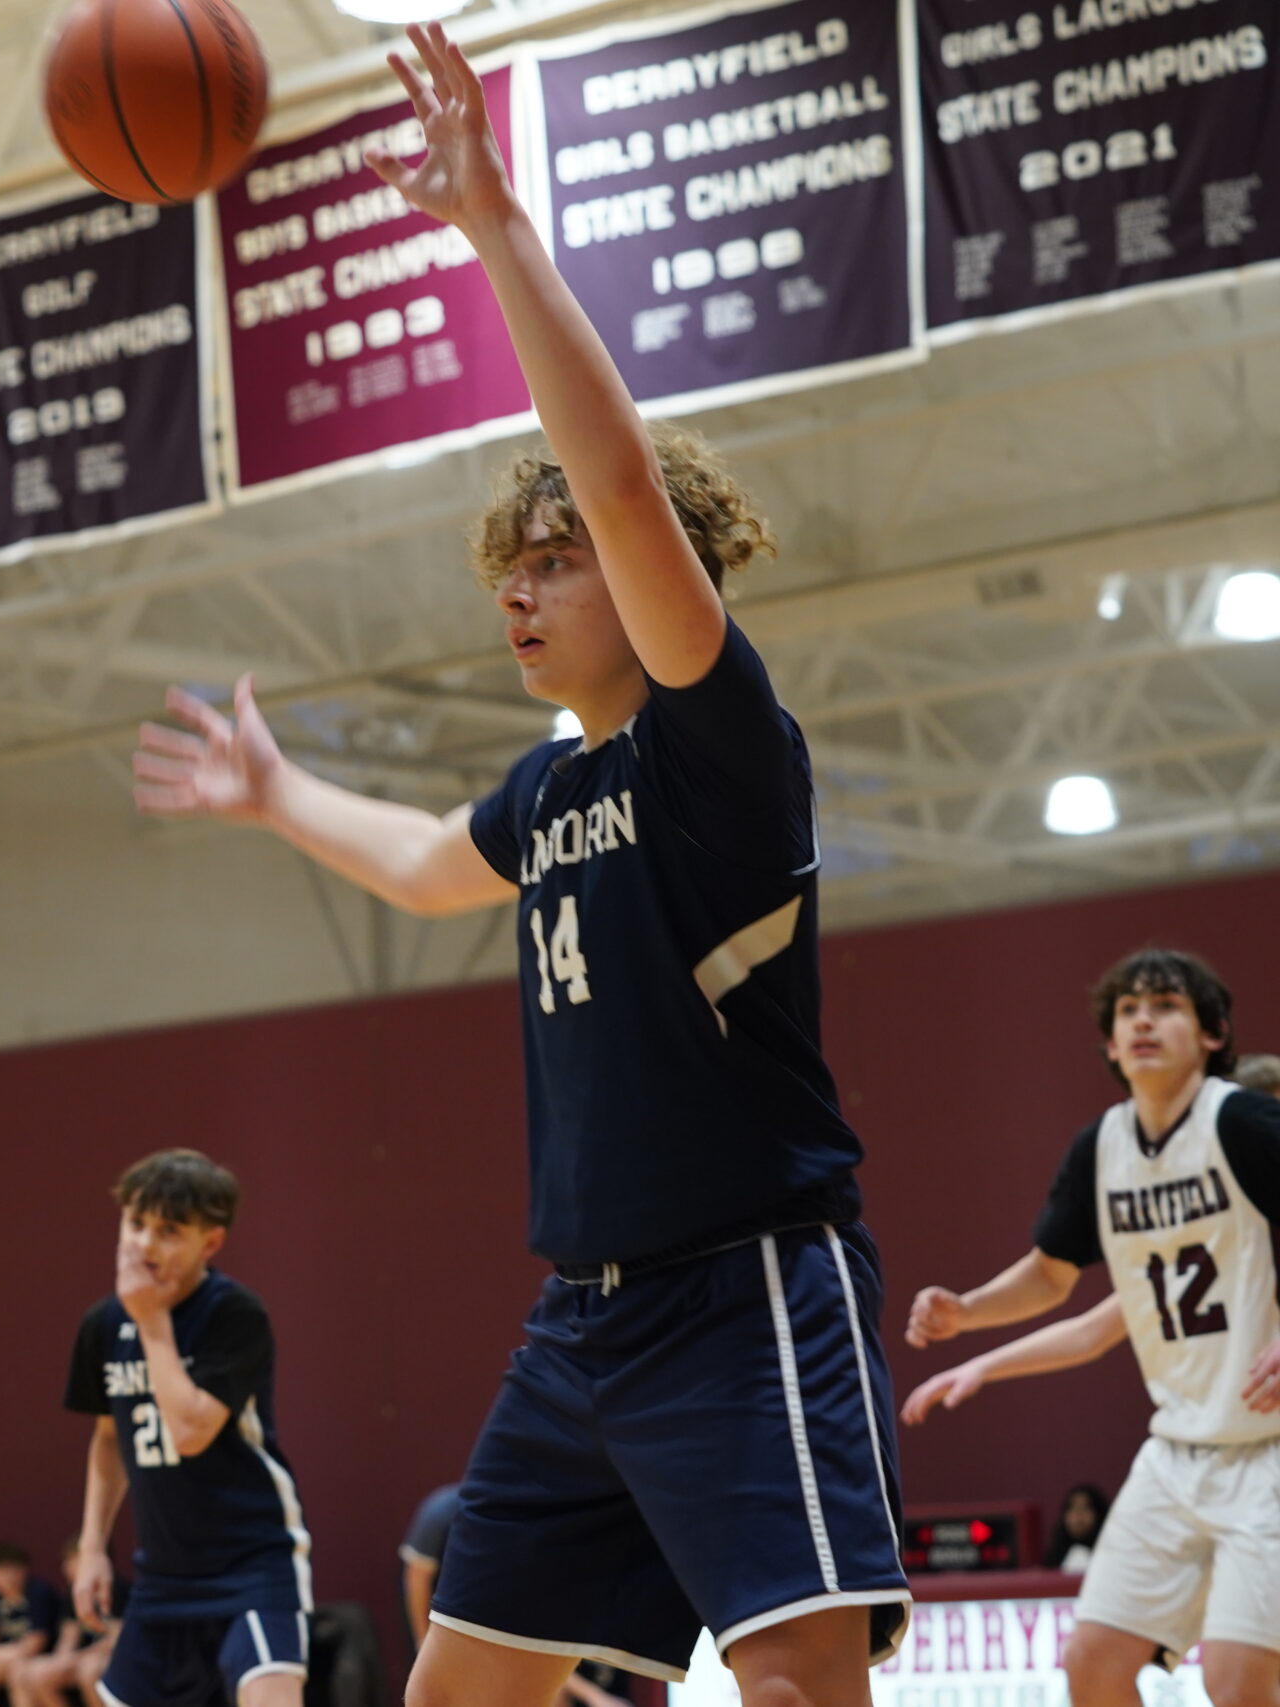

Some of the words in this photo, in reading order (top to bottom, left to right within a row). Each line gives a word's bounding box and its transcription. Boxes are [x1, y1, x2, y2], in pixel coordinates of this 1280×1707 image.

[941, 13, 1042, 68] GIRLS
[937, 80, 1041, 144] STATE
[1053, 25, 1267, 114] CHAMPIONS
[555, 130, 654, 185] GIRLS
[663, 75, 889, 161] BASKETBALL
[1020, 123, 1177, 192] 2021
[562, 184, 676, 249] STATE
[685, 134, 893, 221] CHAMPIONS
[22, 269, 97, 318] GOLF
[234, 265, 328, 330] STATE
[30, 303, 193, 380] CHAMPIONS
[530, 895, 592, 1015] 14
[1147, 1243, 1229, 1341] 12
